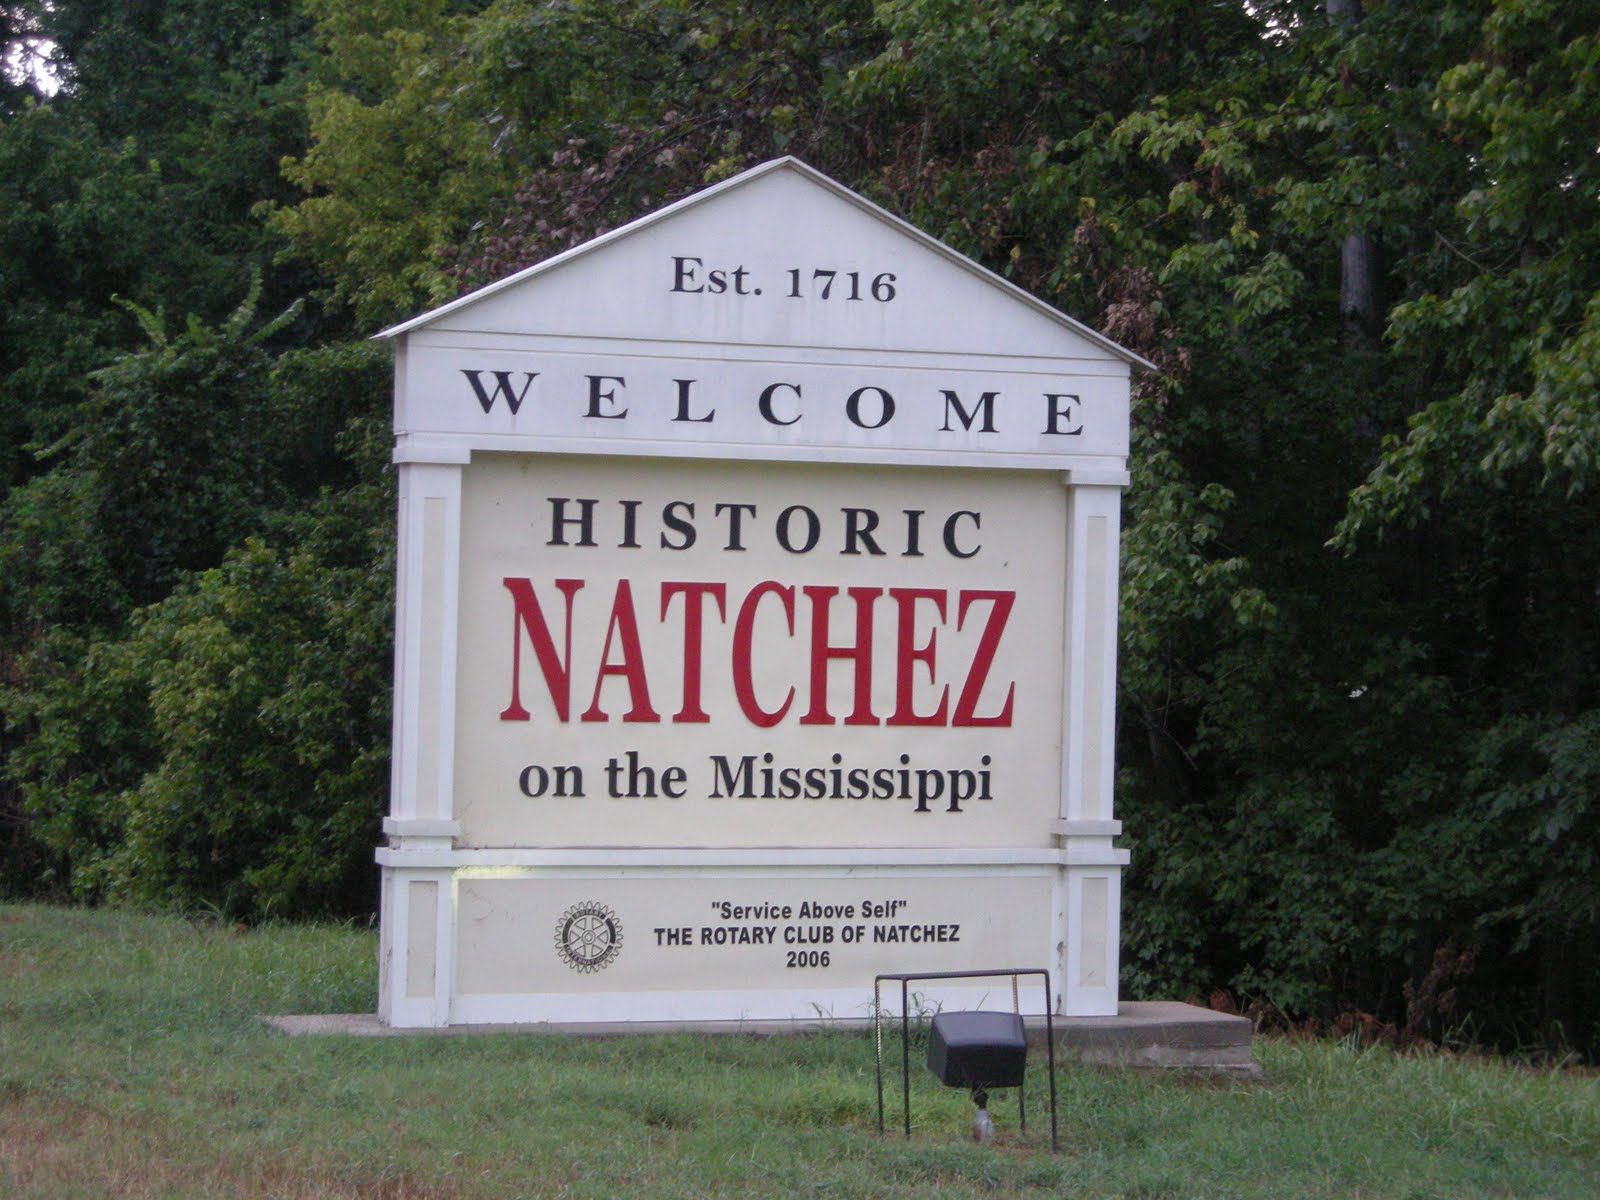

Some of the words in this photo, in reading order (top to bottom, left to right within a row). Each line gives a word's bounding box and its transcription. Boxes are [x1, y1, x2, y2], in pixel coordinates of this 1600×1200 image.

[670, 256, 762, 296] Est.
[787, 268, 897, 304] 1716
[461, 369, 1084, 436] WELCOME
[547, 497, 982, 558] HISTORIC
[500, 577, 1016, 728] NATCHEZ
[520, 765, 585, 798] on
[605, 751, 687, 799] the
[709, 752, 993, 813] Mississippi
[653, 927, 694, 946] THE
[701, 926, 778, 945] ROTARY
[783, 925, 835, 944] CLUB
[841, 925, 867, 944] OF
[873, 924, 961, 943] NATCHEZ
[711, 901, 793, 920] "Service
[798, 901, 856, 919] Above
[861, 900, 907, 919] Self"
[786, 950, 830, 969] 2006
